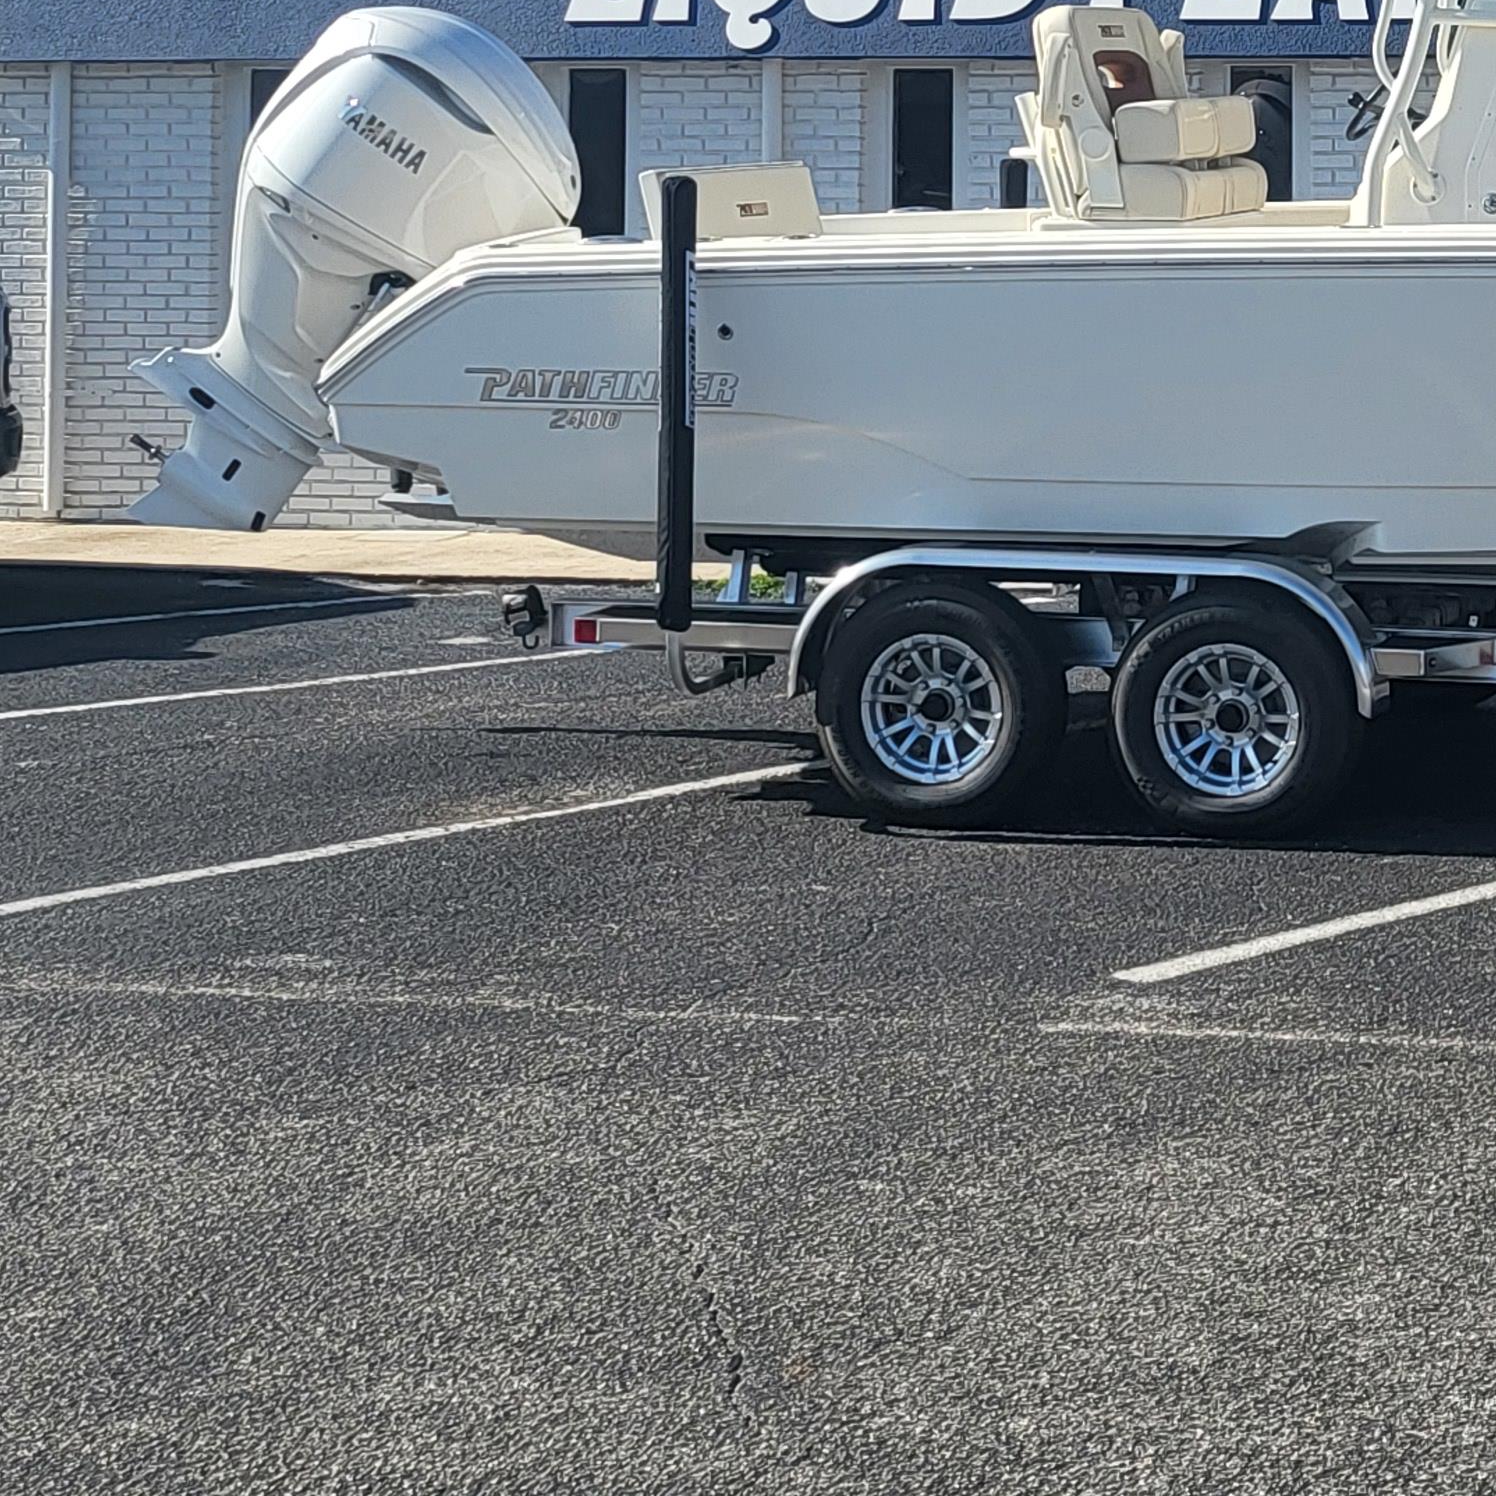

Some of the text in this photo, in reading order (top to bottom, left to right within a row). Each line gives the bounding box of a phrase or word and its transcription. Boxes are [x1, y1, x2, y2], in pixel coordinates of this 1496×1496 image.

[340, 98, 428, 175] YAMAHA
[464, 367, 740, 406] PATHFINER
[549, 409, 622, 430] 2400
